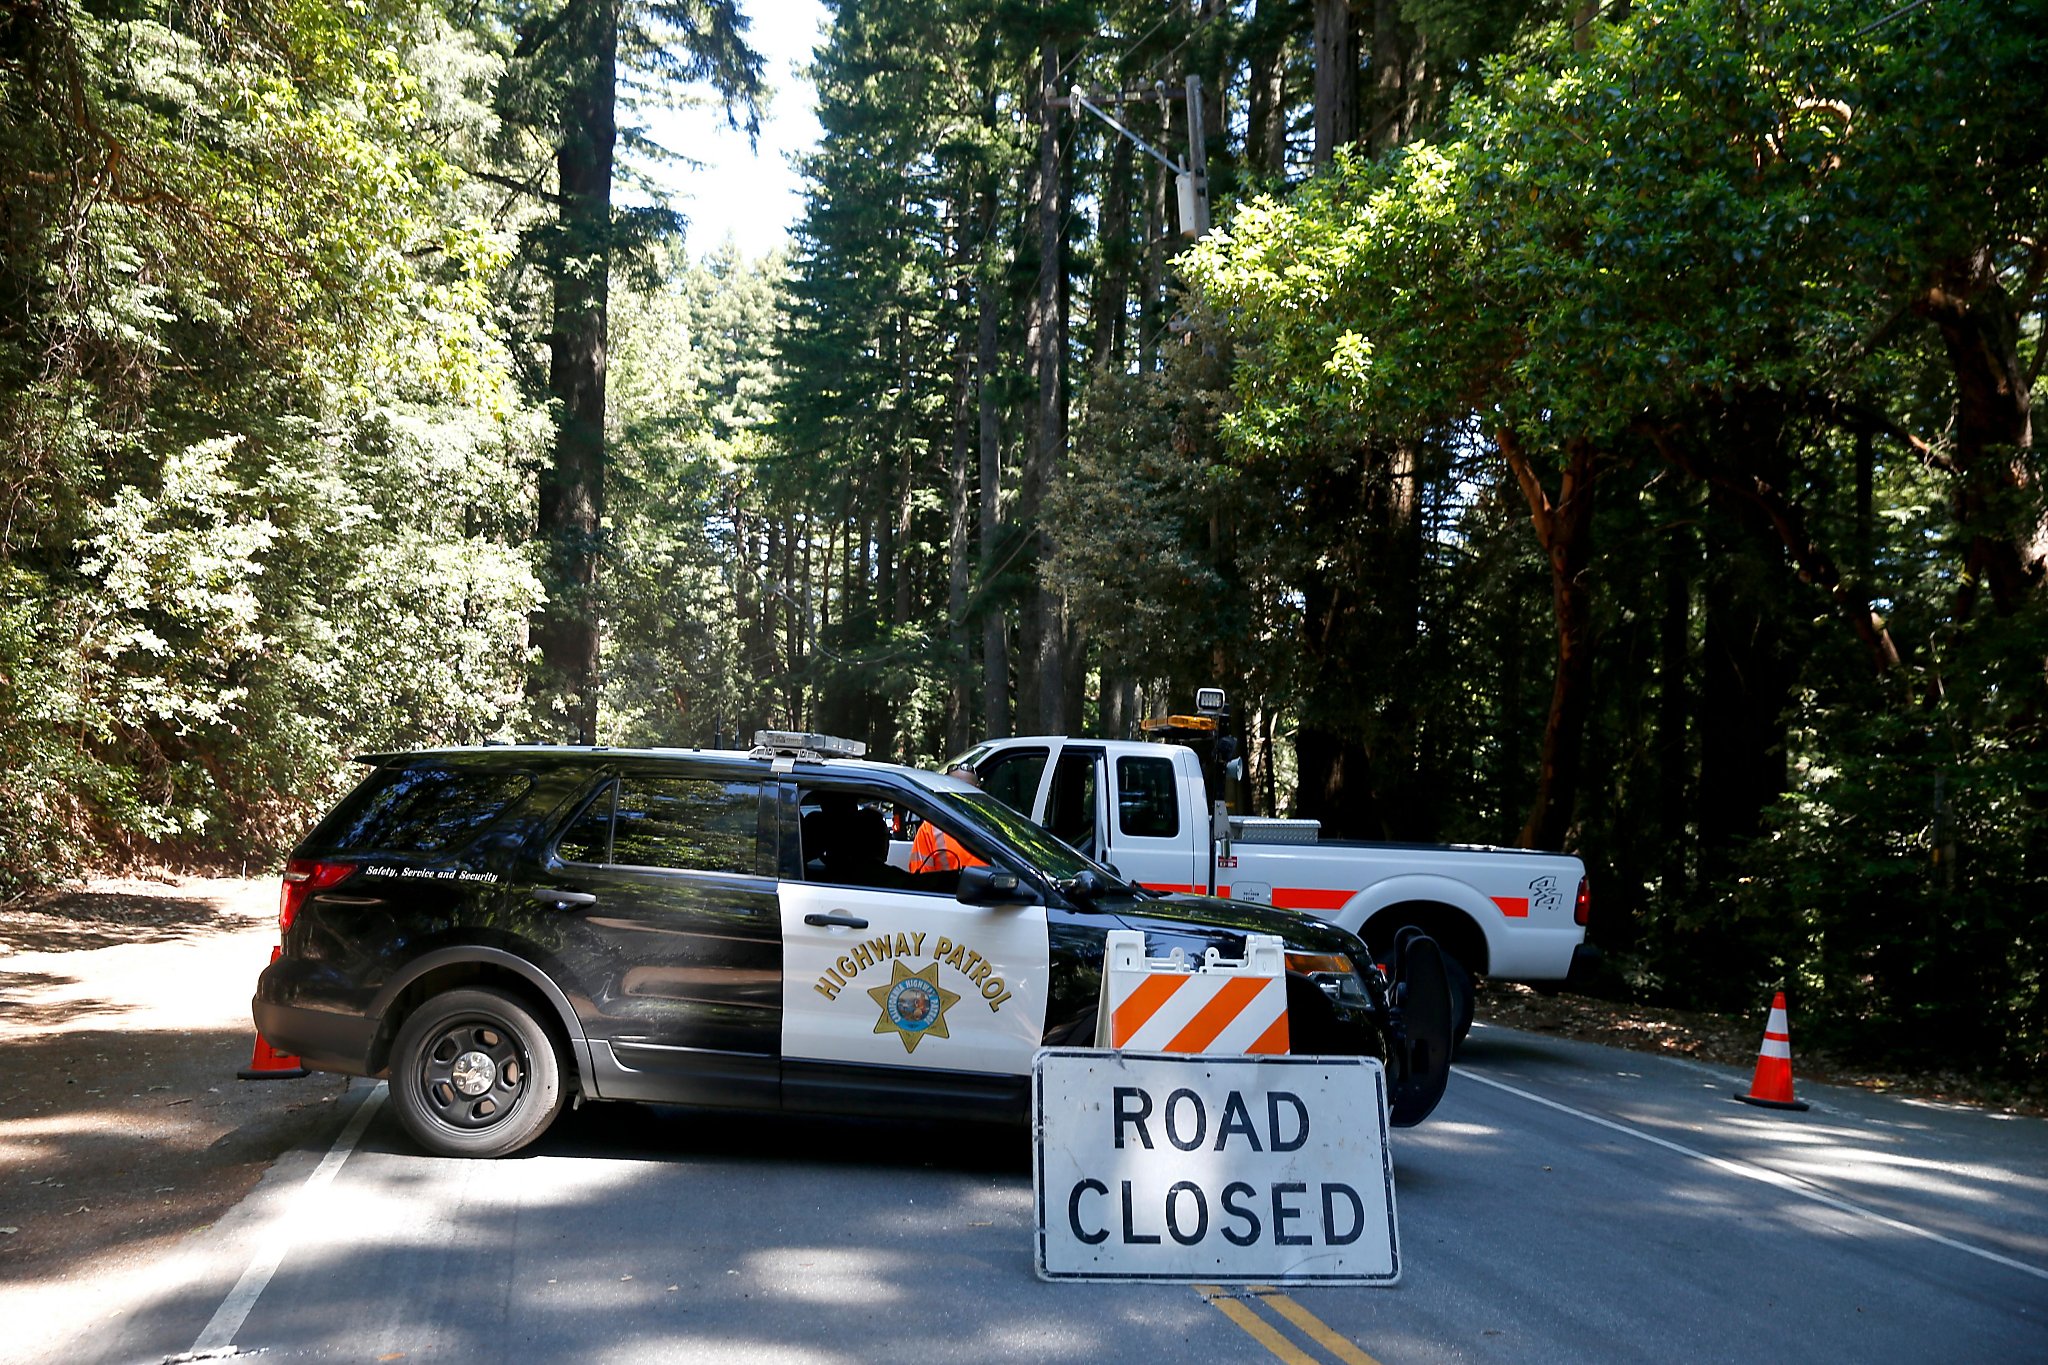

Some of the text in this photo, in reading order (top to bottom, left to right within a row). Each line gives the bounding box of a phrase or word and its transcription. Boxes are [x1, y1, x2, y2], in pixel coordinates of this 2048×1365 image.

[366, 865, 498, 883] Safety, Service and Security
[813, 931, 1013, 1013] HIGHWAY PATROL
[905, 979, 936, 998] HIGHWAY
[1113, 1086, 1310, 1152] ROAD
[1068, 1178, 1365, 1247] CLOSED
